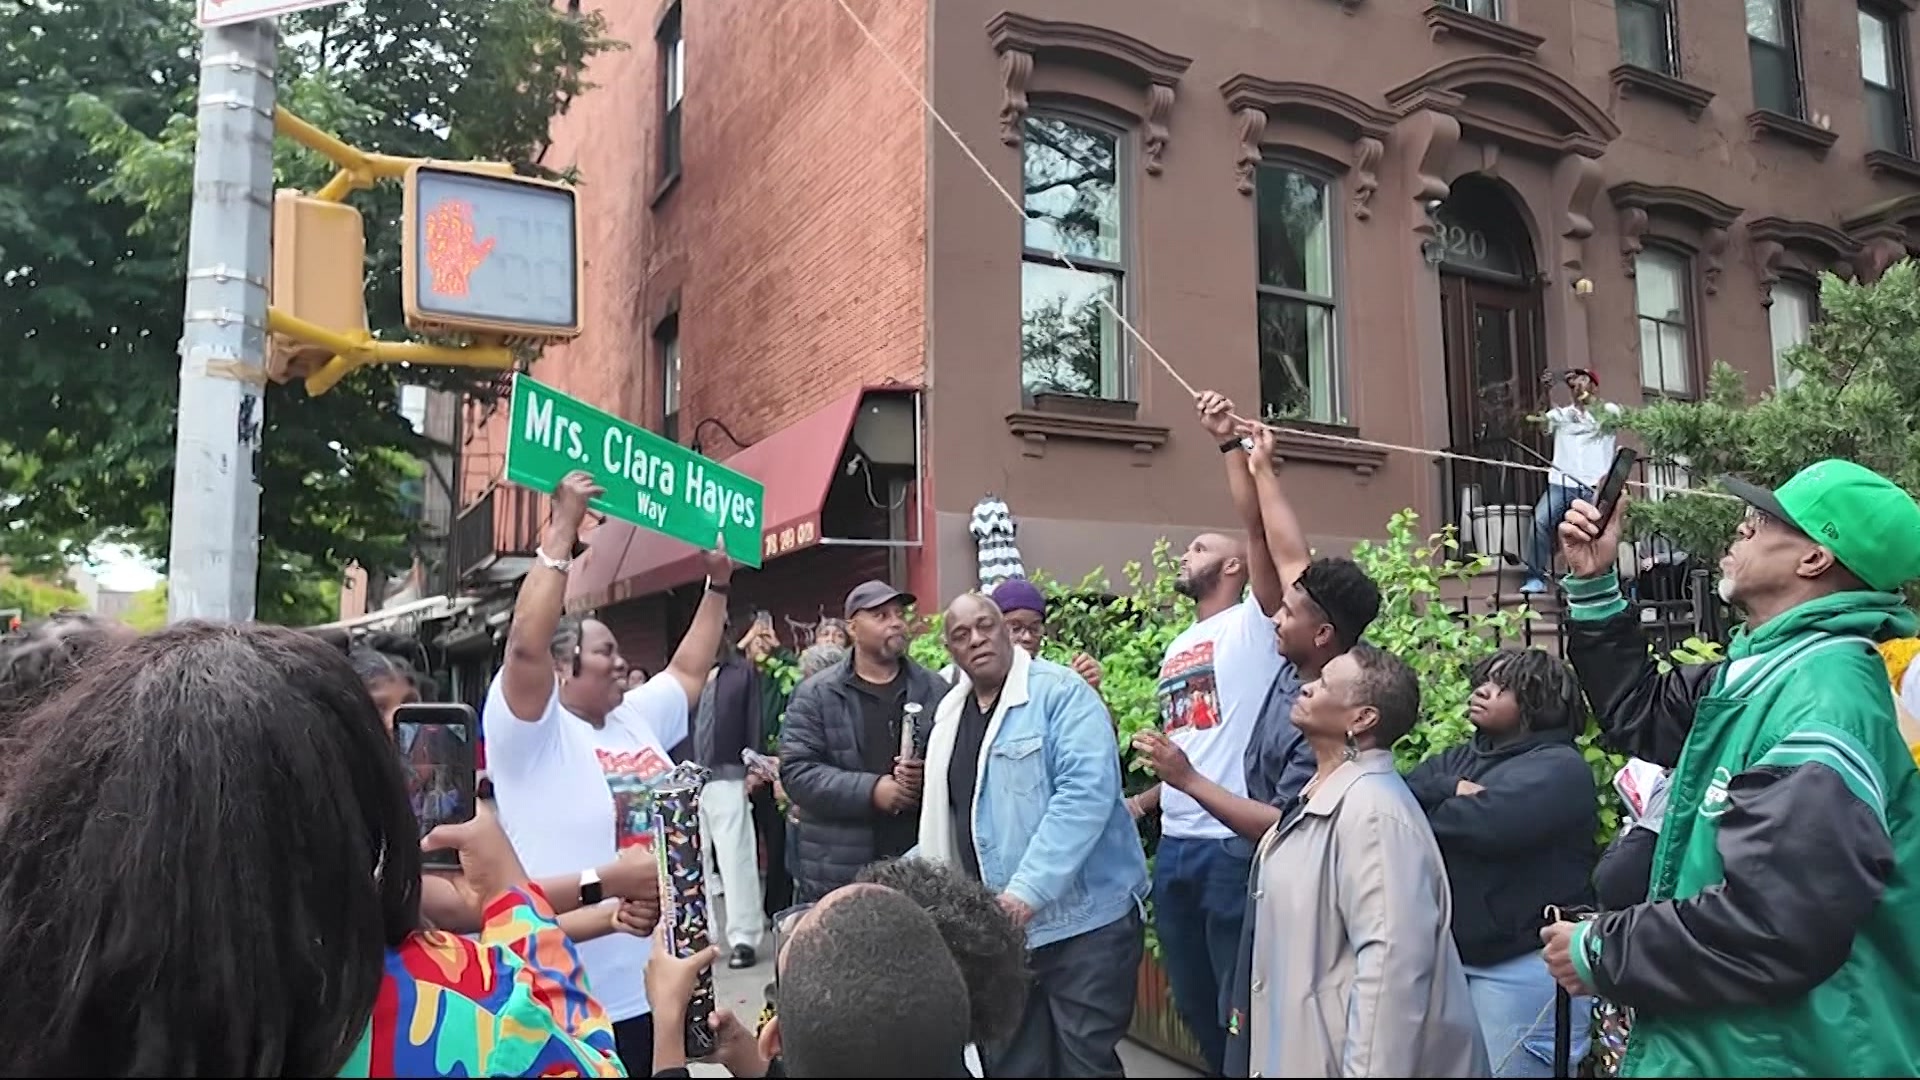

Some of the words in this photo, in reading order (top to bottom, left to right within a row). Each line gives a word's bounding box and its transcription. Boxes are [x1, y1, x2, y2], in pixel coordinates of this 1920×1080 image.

[524, 390, 590, 463] Mrs.
[603, 426, 675, 496] Clara
[685, 461, 756, 529] Hayes
[637, 490, 668, 527] Way
